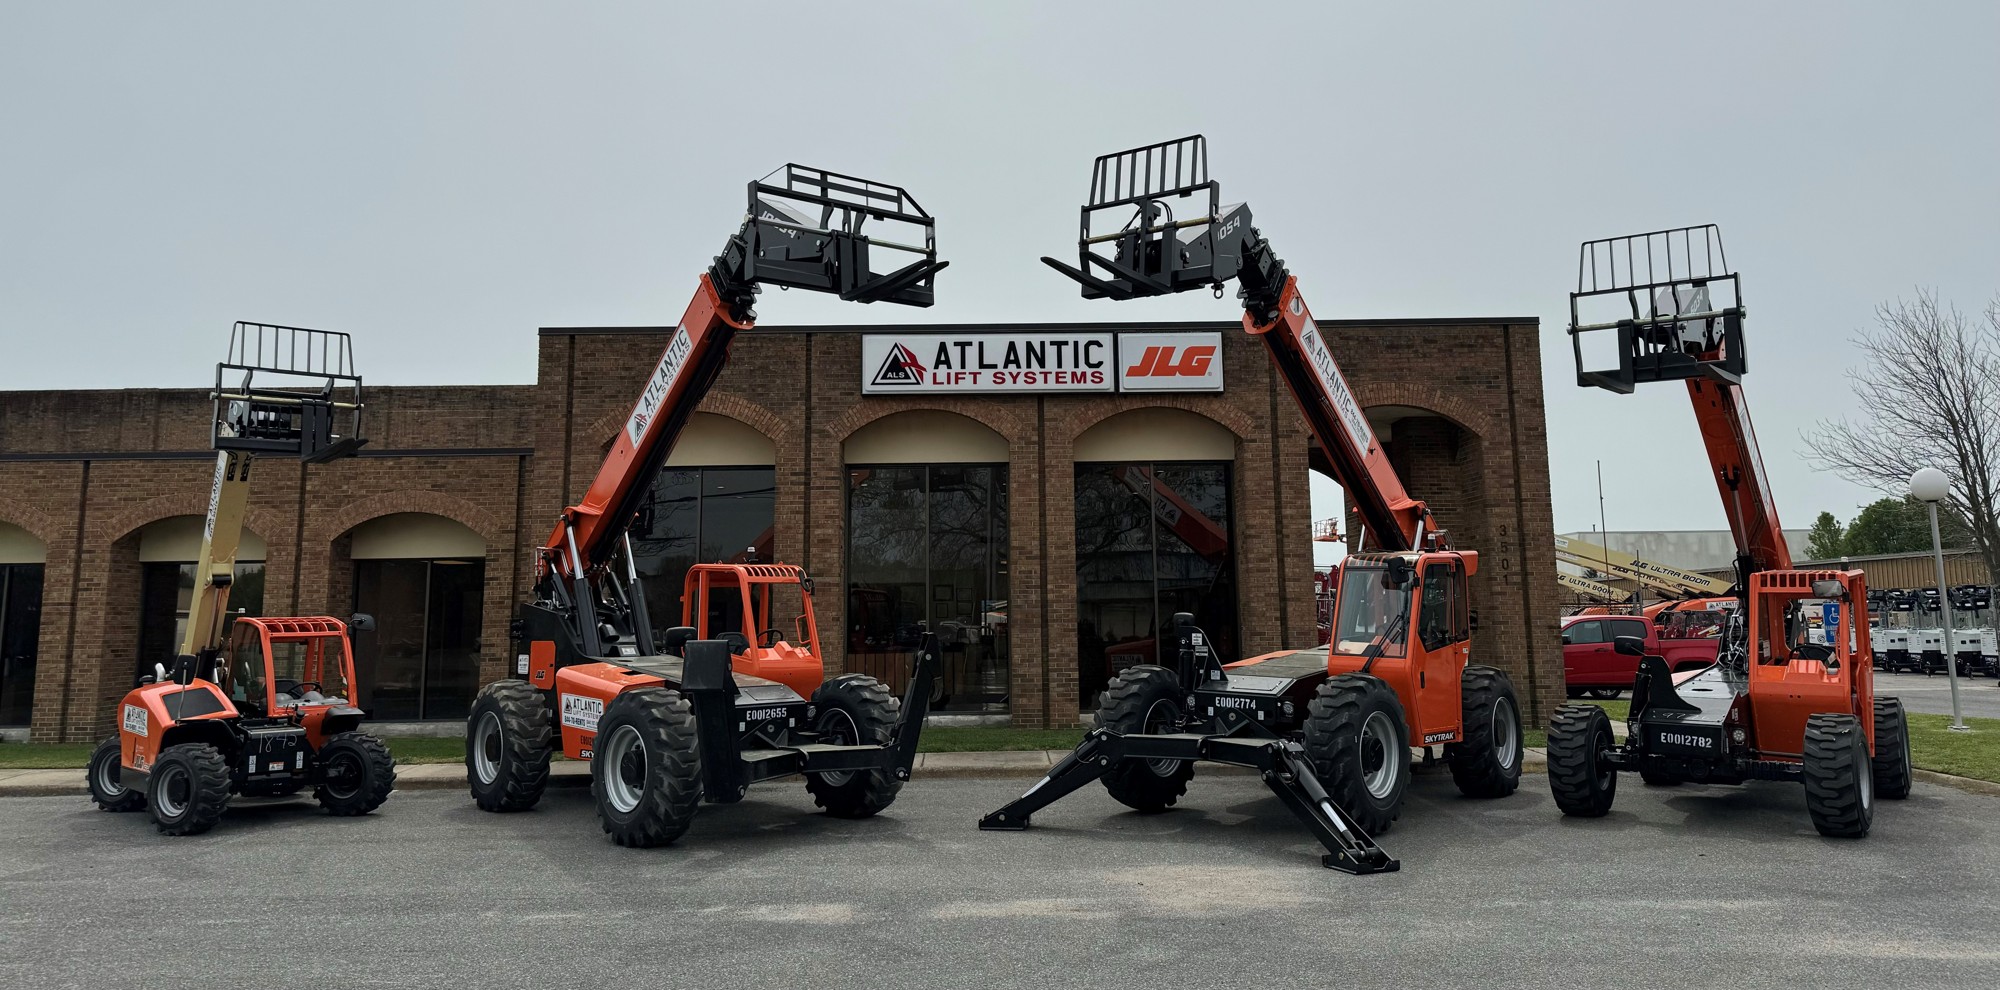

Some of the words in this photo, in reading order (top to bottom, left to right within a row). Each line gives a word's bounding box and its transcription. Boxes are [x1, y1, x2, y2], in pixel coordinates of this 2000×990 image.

[933, 340, 1104, 370] ATLANTIC
[1125, 346, 1217, 377] JLG
[643, 329, 687, 412] ATLANTIC
[932, 372, 982, 385] LIFT
[992, 371, 1104, 385] SYSTEMS
[647, 396, 661, 419] LIFT
[661, 342, 691, 394] SYSTEMS
[1316, 346, 1352, 413] ATLANTIC
[1630, 560, 1648, 570] JLG
[1650, 565, 1681, 577] ULTRA
[1682, 574, 1711, 587] BOOM
[1569, 577, 1591, 589] ULTRA
[535, 671, 545, 679] JLG
[573, 698, 602, 714] ATLANTIC
[1215, 696, 1256, 710] E0012774
[746, 707, 787, 721] E0012655
[1425, 732, 1454, 743] SKYTRAK
[1660, 732, 1712, 748] E0012782
